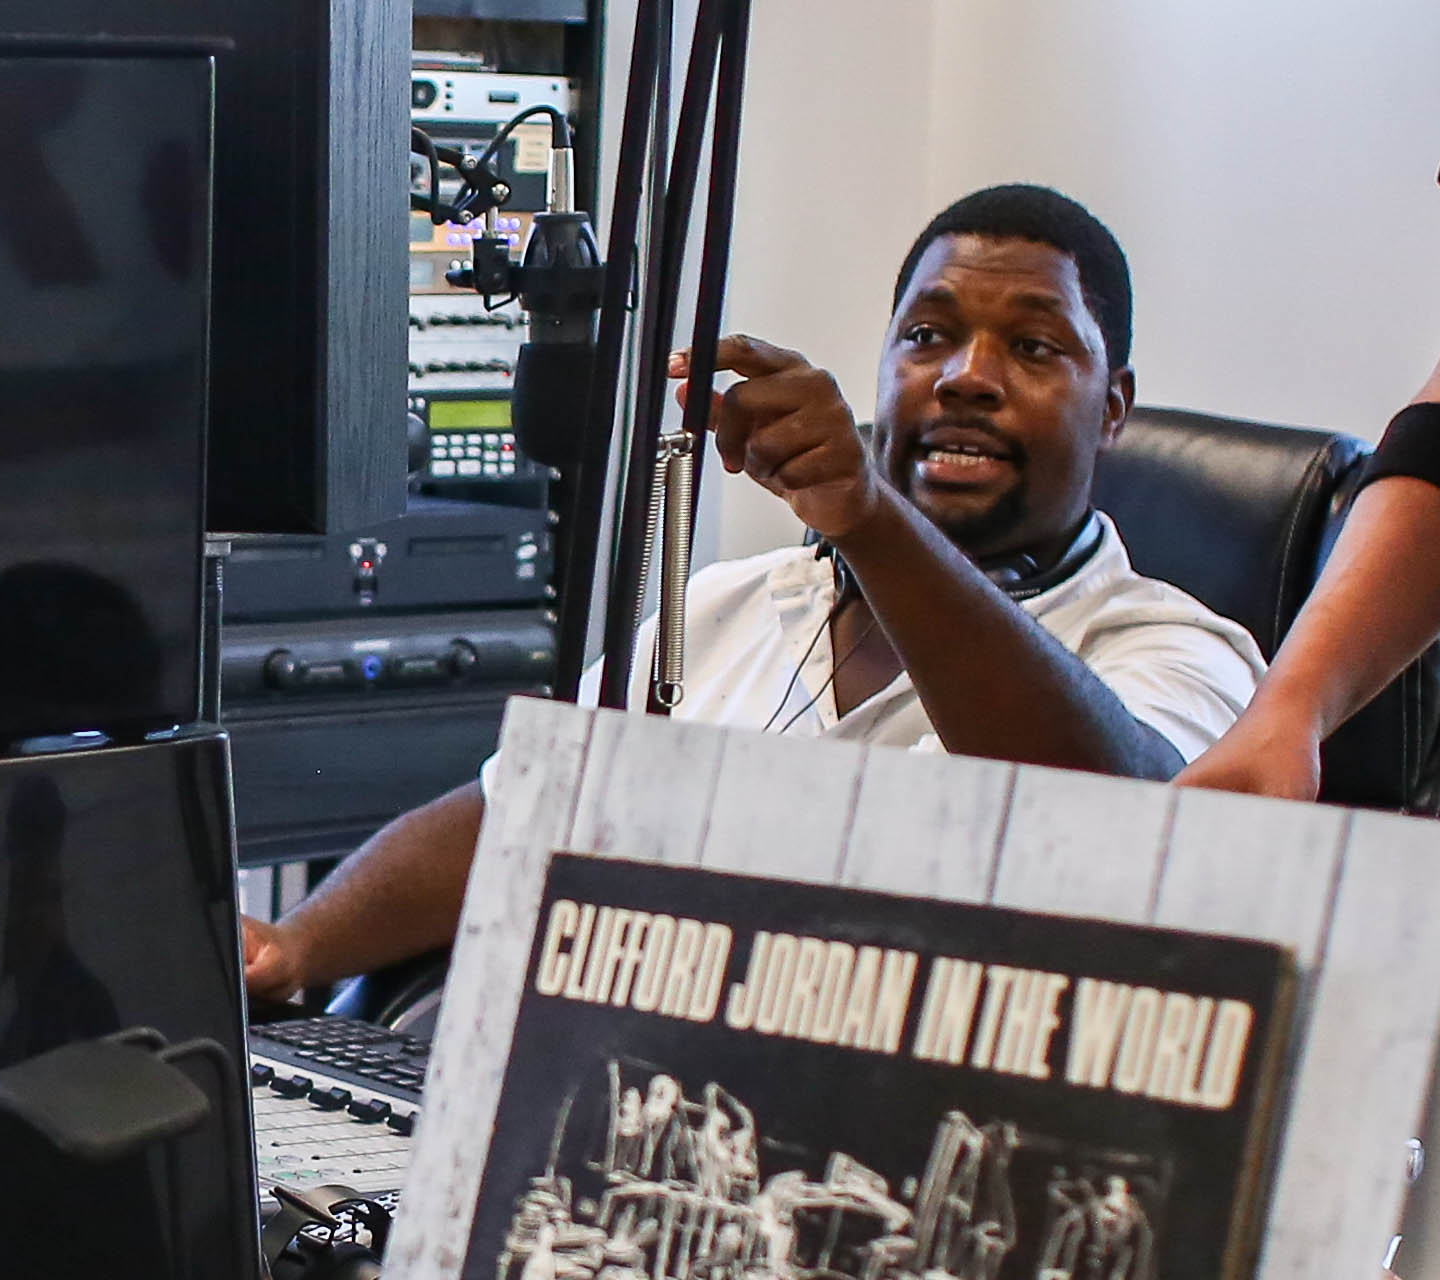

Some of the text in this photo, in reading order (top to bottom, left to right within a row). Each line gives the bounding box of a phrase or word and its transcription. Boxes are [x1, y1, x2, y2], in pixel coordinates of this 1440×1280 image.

[535, 898, 1256, 1112] CLIFFORD JORDAN IN THE WORLD
